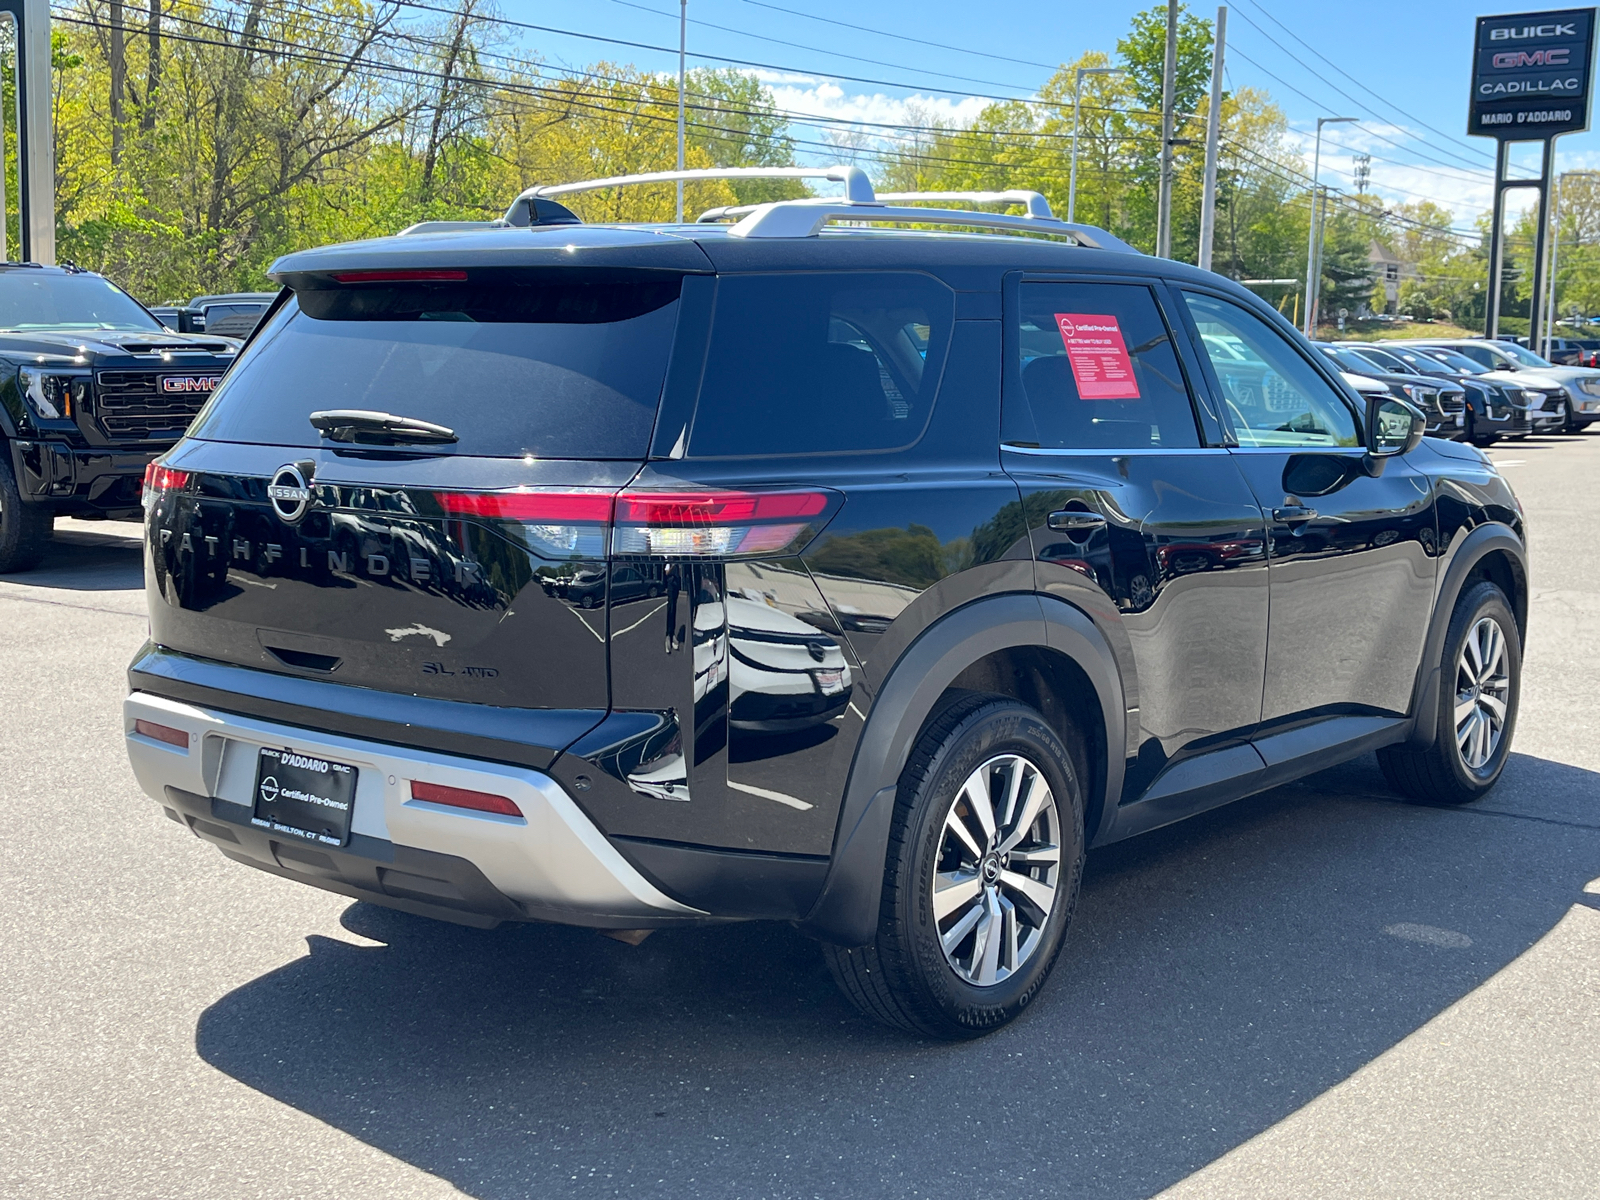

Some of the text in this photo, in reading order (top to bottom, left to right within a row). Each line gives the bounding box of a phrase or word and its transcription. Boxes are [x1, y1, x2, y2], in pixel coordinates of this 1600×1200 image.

[1490, 23, 1576, 41] BUICK
[1492, 48, 1570, 69] GMC
[1479, 78, 1578, 95] CADILLAC
[1481, 110, 1571, 125] MARIO D'ADDARIO
[268, 486, 308, 499] NISSAN
[159, 528, 480, 590] PATHFINDER
[422, 661, 499, 678] SL 4WD
[261, 749, 351, 774] BUICK D'ADDARIO GMC
[281, 788, 348, 811] Certified Pre-Owned
[274, 823, 305, 838] SHELTON,
[306, 831, 317, 840] CT
[919, 824, 935, 927] CRUGEN
